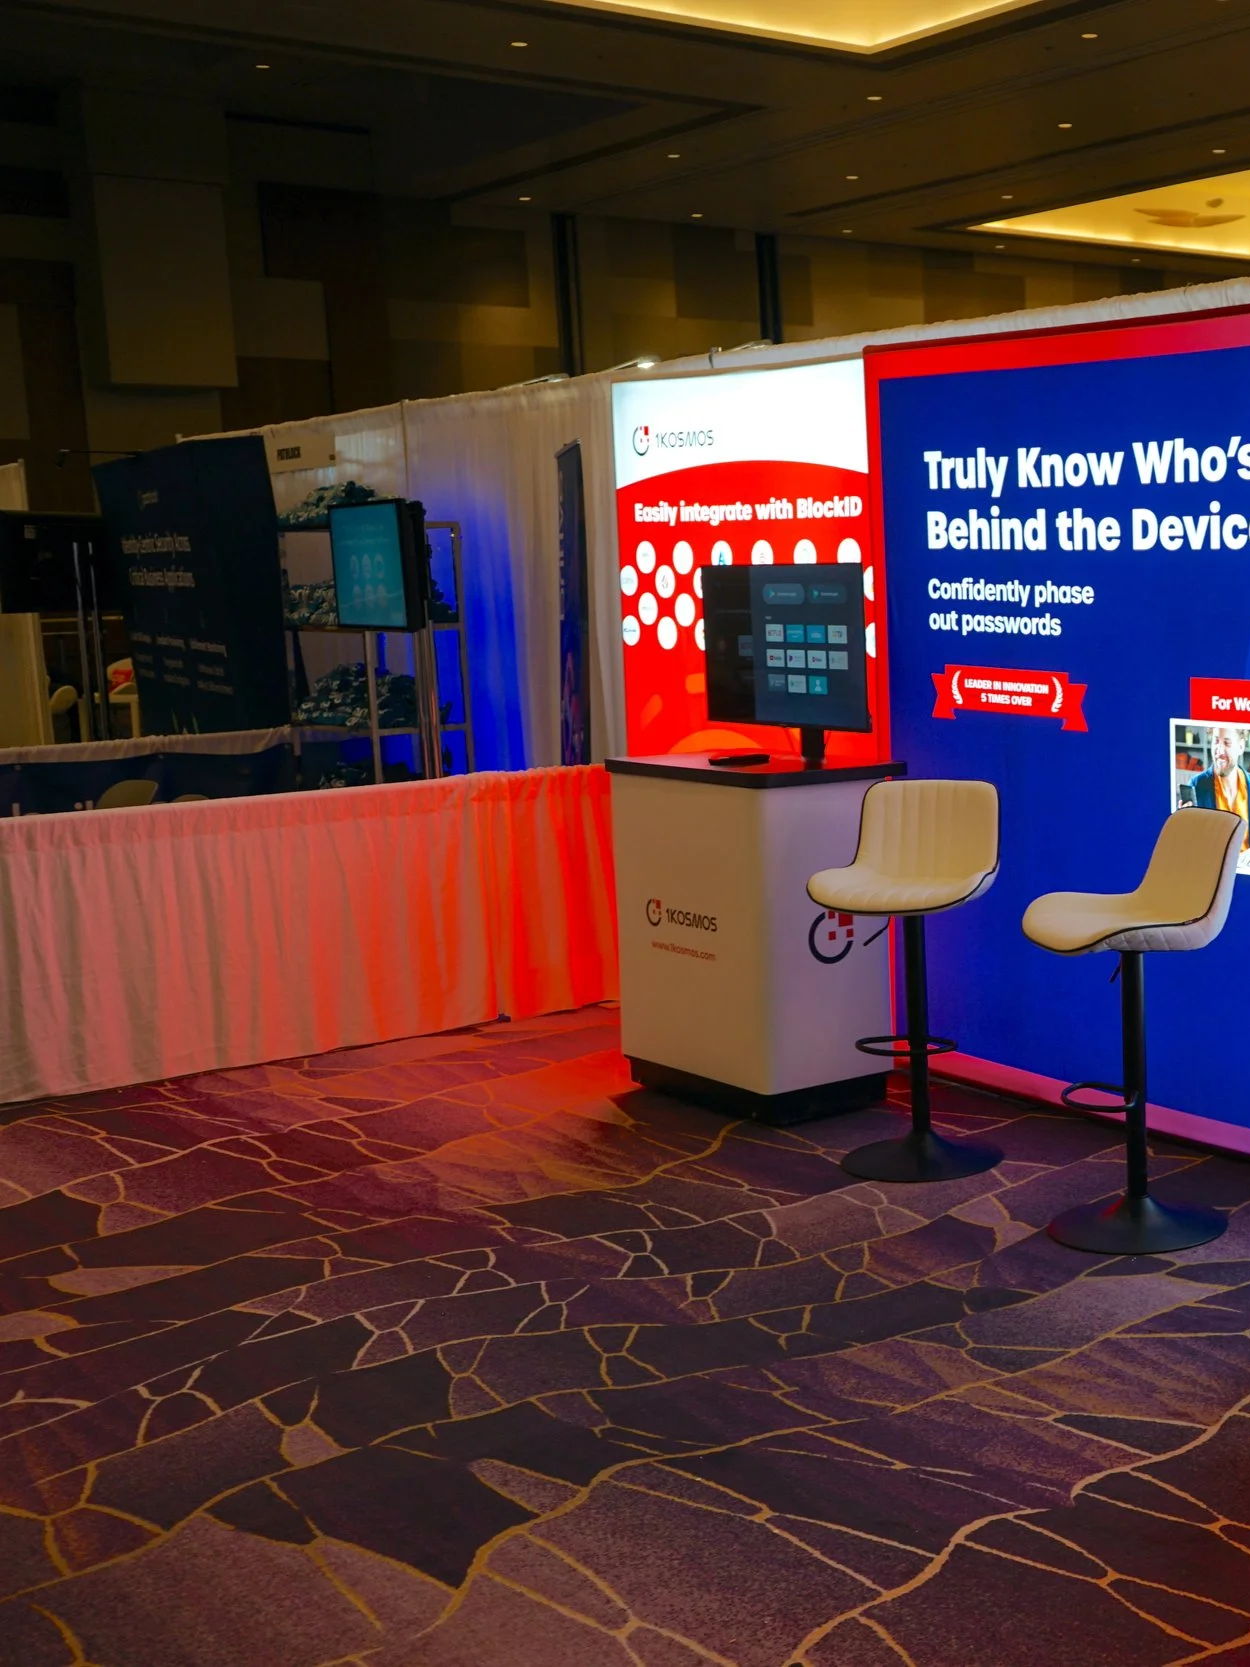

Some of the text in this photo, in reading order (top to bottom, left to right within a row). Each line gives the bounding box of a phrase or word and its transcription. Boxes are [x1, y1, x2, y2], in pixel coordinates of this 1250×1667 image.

[655, 430, 714, 448] 1KOSMOS
[924, 447, 1008, 498] Truly
[1017, 447, 1125, 488] Know
[634, 496, 862, 526] Easily integrate with BlockID
[926, 506, 1047, 550] Behind
[1056, 507, 1121, 551] the
[928, 577, 1095, 608] Confidently phase
[929, 611, 1062, 638] out passwords
[964, 678, 1049, 695] LEADER IN INNOVATION
[980, 692, 1032, 707] 5 TIMES OVER
[1211, 695, 1231, 711] For
[665, 908, 717, 932] 1KOSMOS
